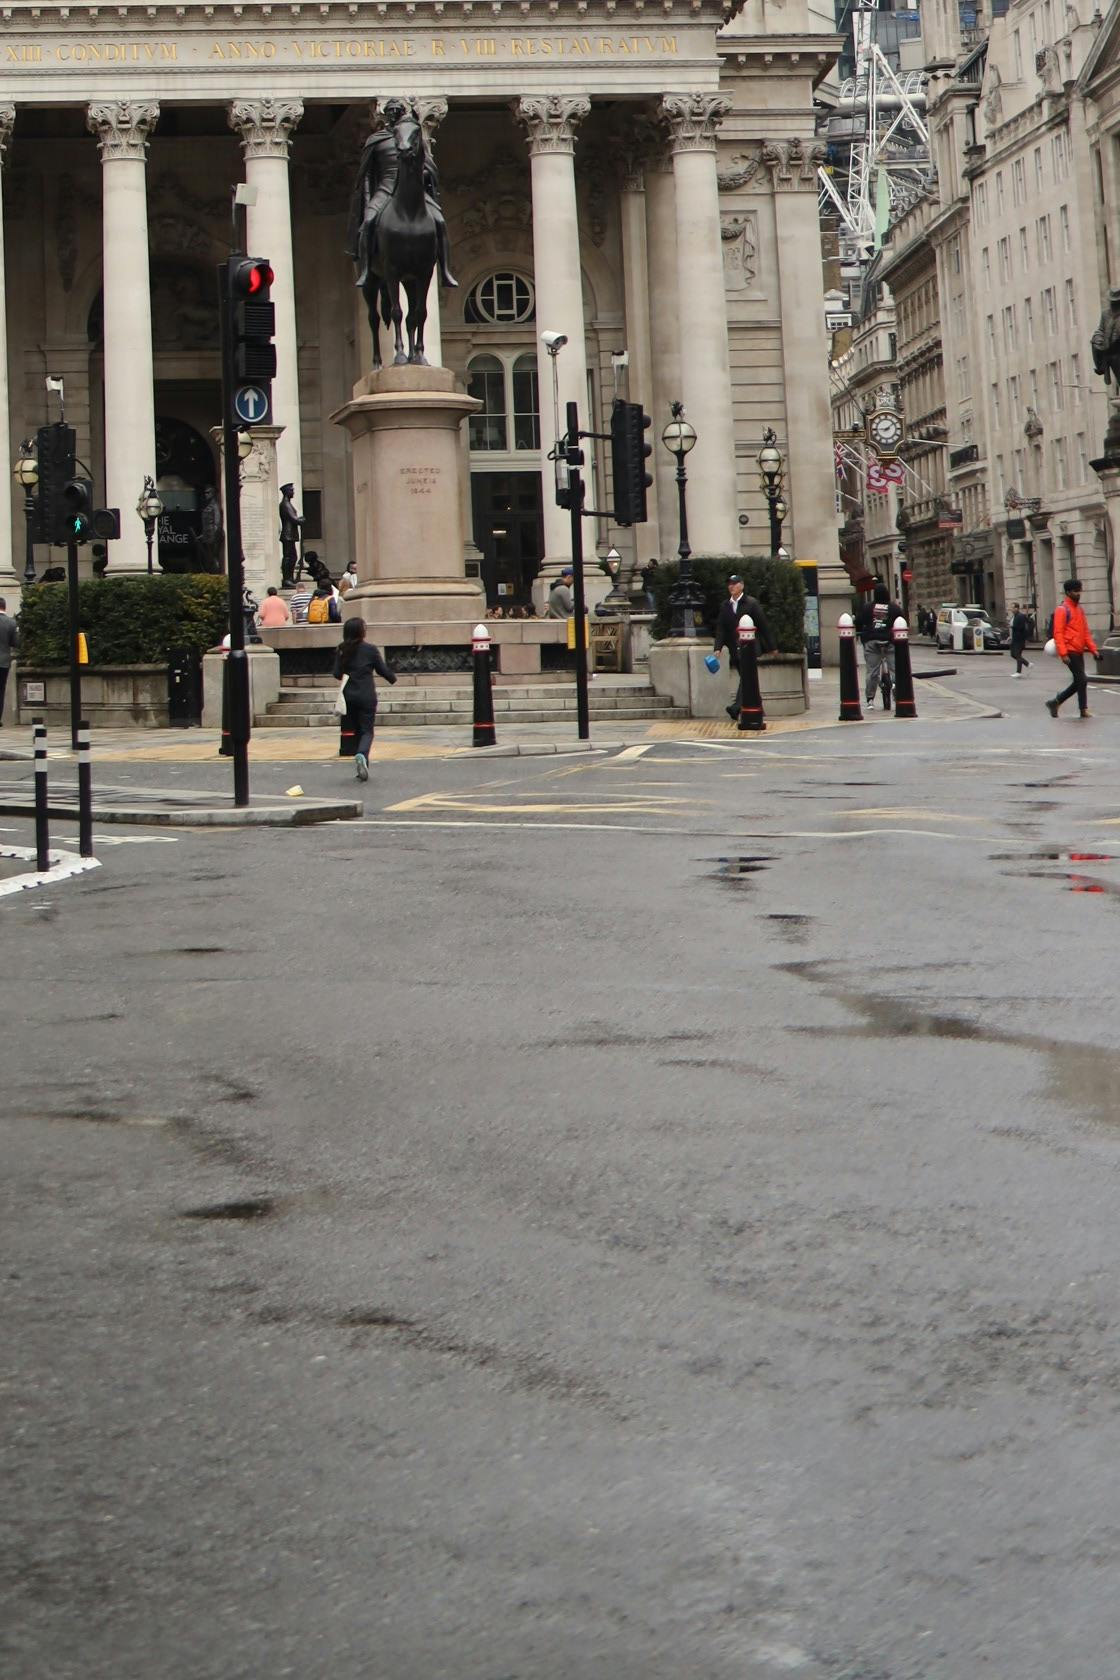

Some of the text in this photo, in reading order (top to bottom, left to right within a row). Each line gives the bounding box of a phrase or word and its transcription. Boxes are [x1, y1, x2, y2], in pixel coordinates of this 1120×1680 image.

[5, 44, 43, 62] XIII
[55, 42, 178, 61] CONDITVM
[208, 41, 278, 60] ANNO
[291, 39, 417, 58] VICTORIAE
[431, 38, 446, 56] R
[460, 37, 497, 56] VIII
[510, 35, 679, 56] RESTAVRATVM
[159, 525, 177, 535] YAL
[159, 534, 189, 544] ANGE
